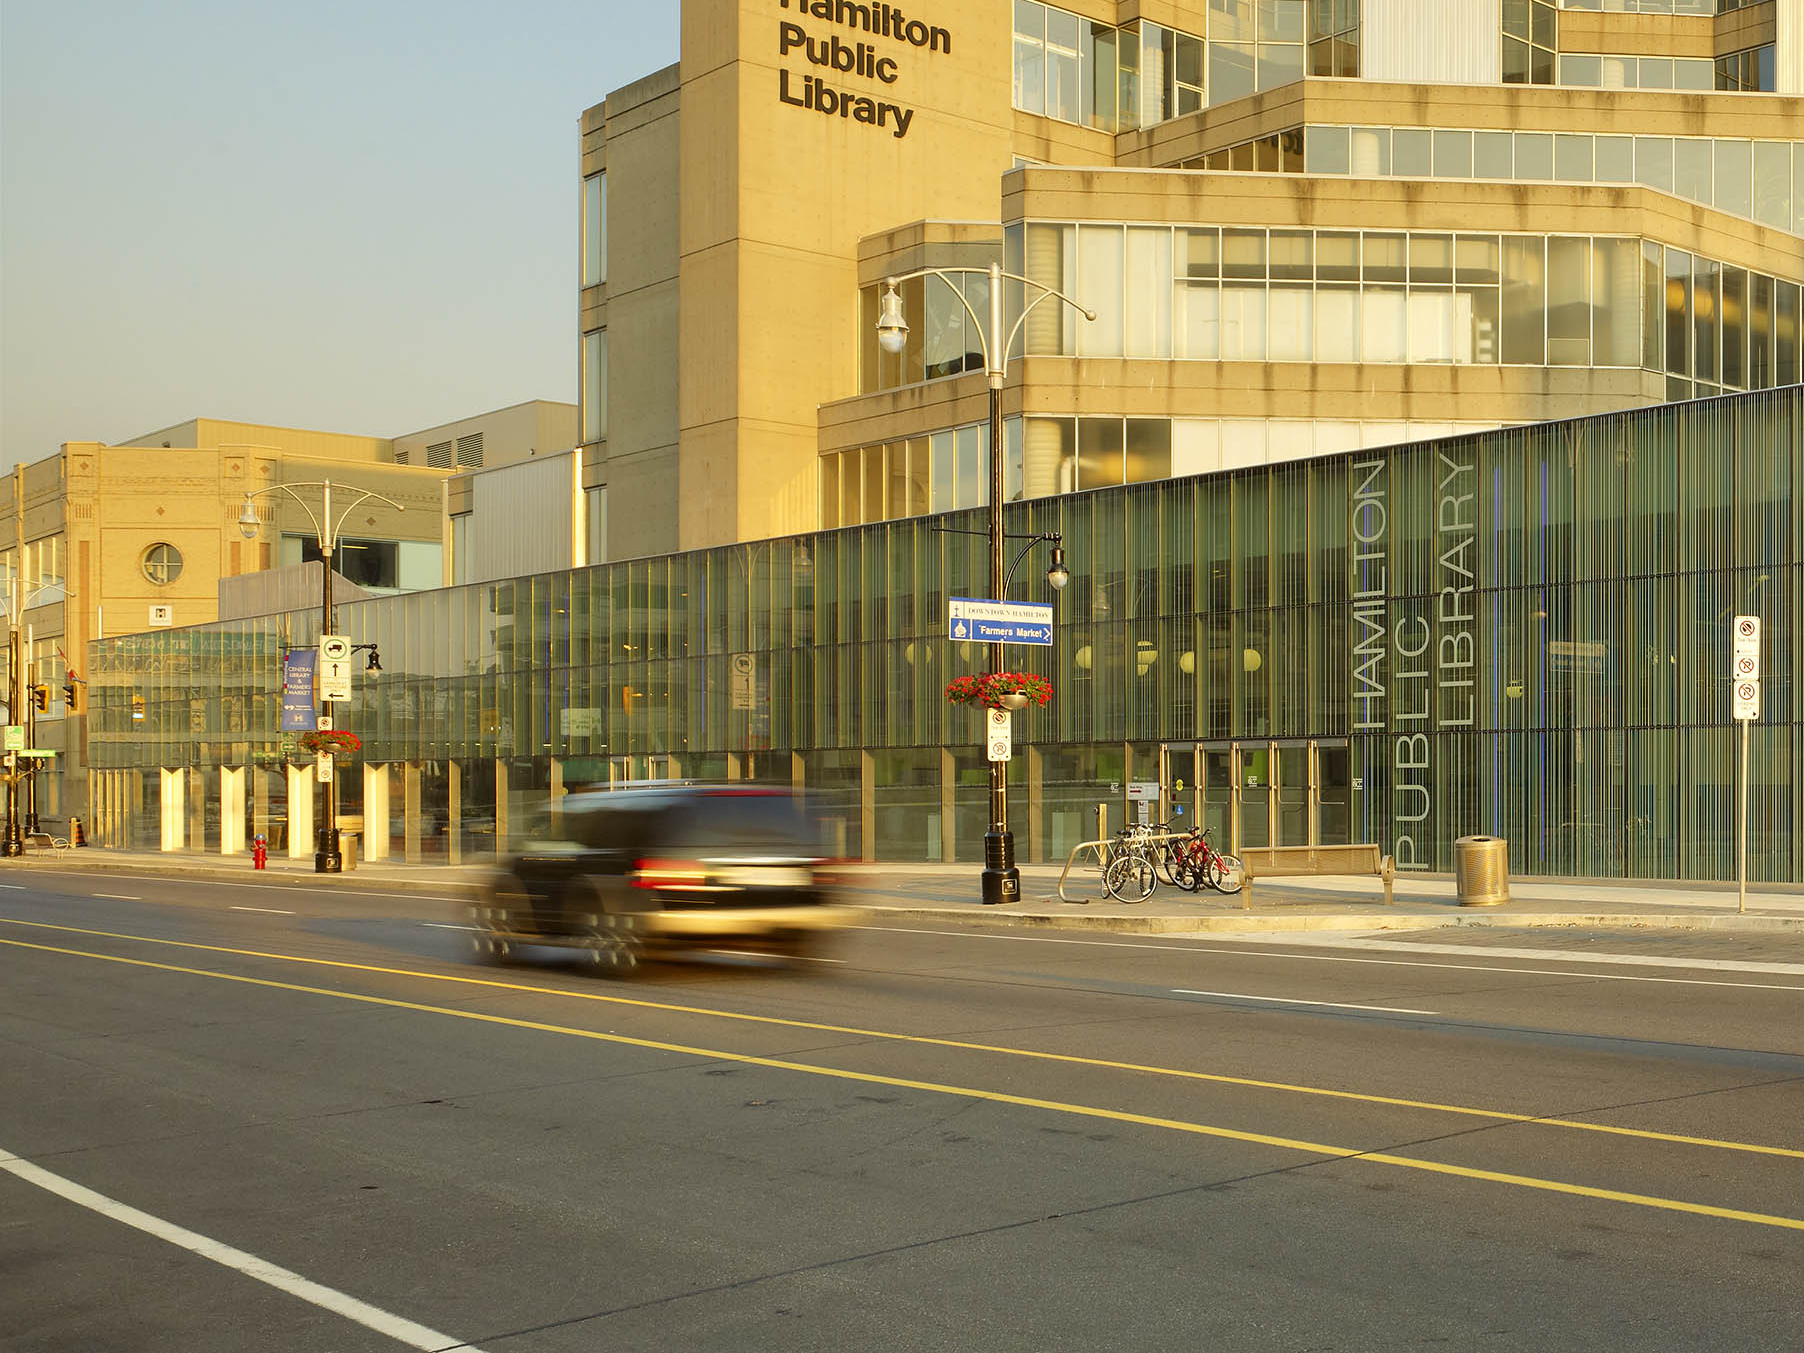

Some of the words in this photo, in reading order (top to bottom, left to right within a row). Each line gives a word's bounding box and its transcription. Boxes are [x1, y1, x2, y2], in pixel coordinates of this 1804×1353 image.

[779, 20, 899, 85] Public
[779, 68, 915, 139] Library
[968, 607, 1010, 617] DOWNTOWN
[1012, 611, 1049, 619] HAMILTON
[1352, 458, 1386, 730] HAMILTON
[1438, 452, 1474, 727] LIBRARY
[979, 625, 1013, 636] Farmers
[1016, 628, 1043, 638] Market
[1394, 615, 1431, 870] PUBLIC
